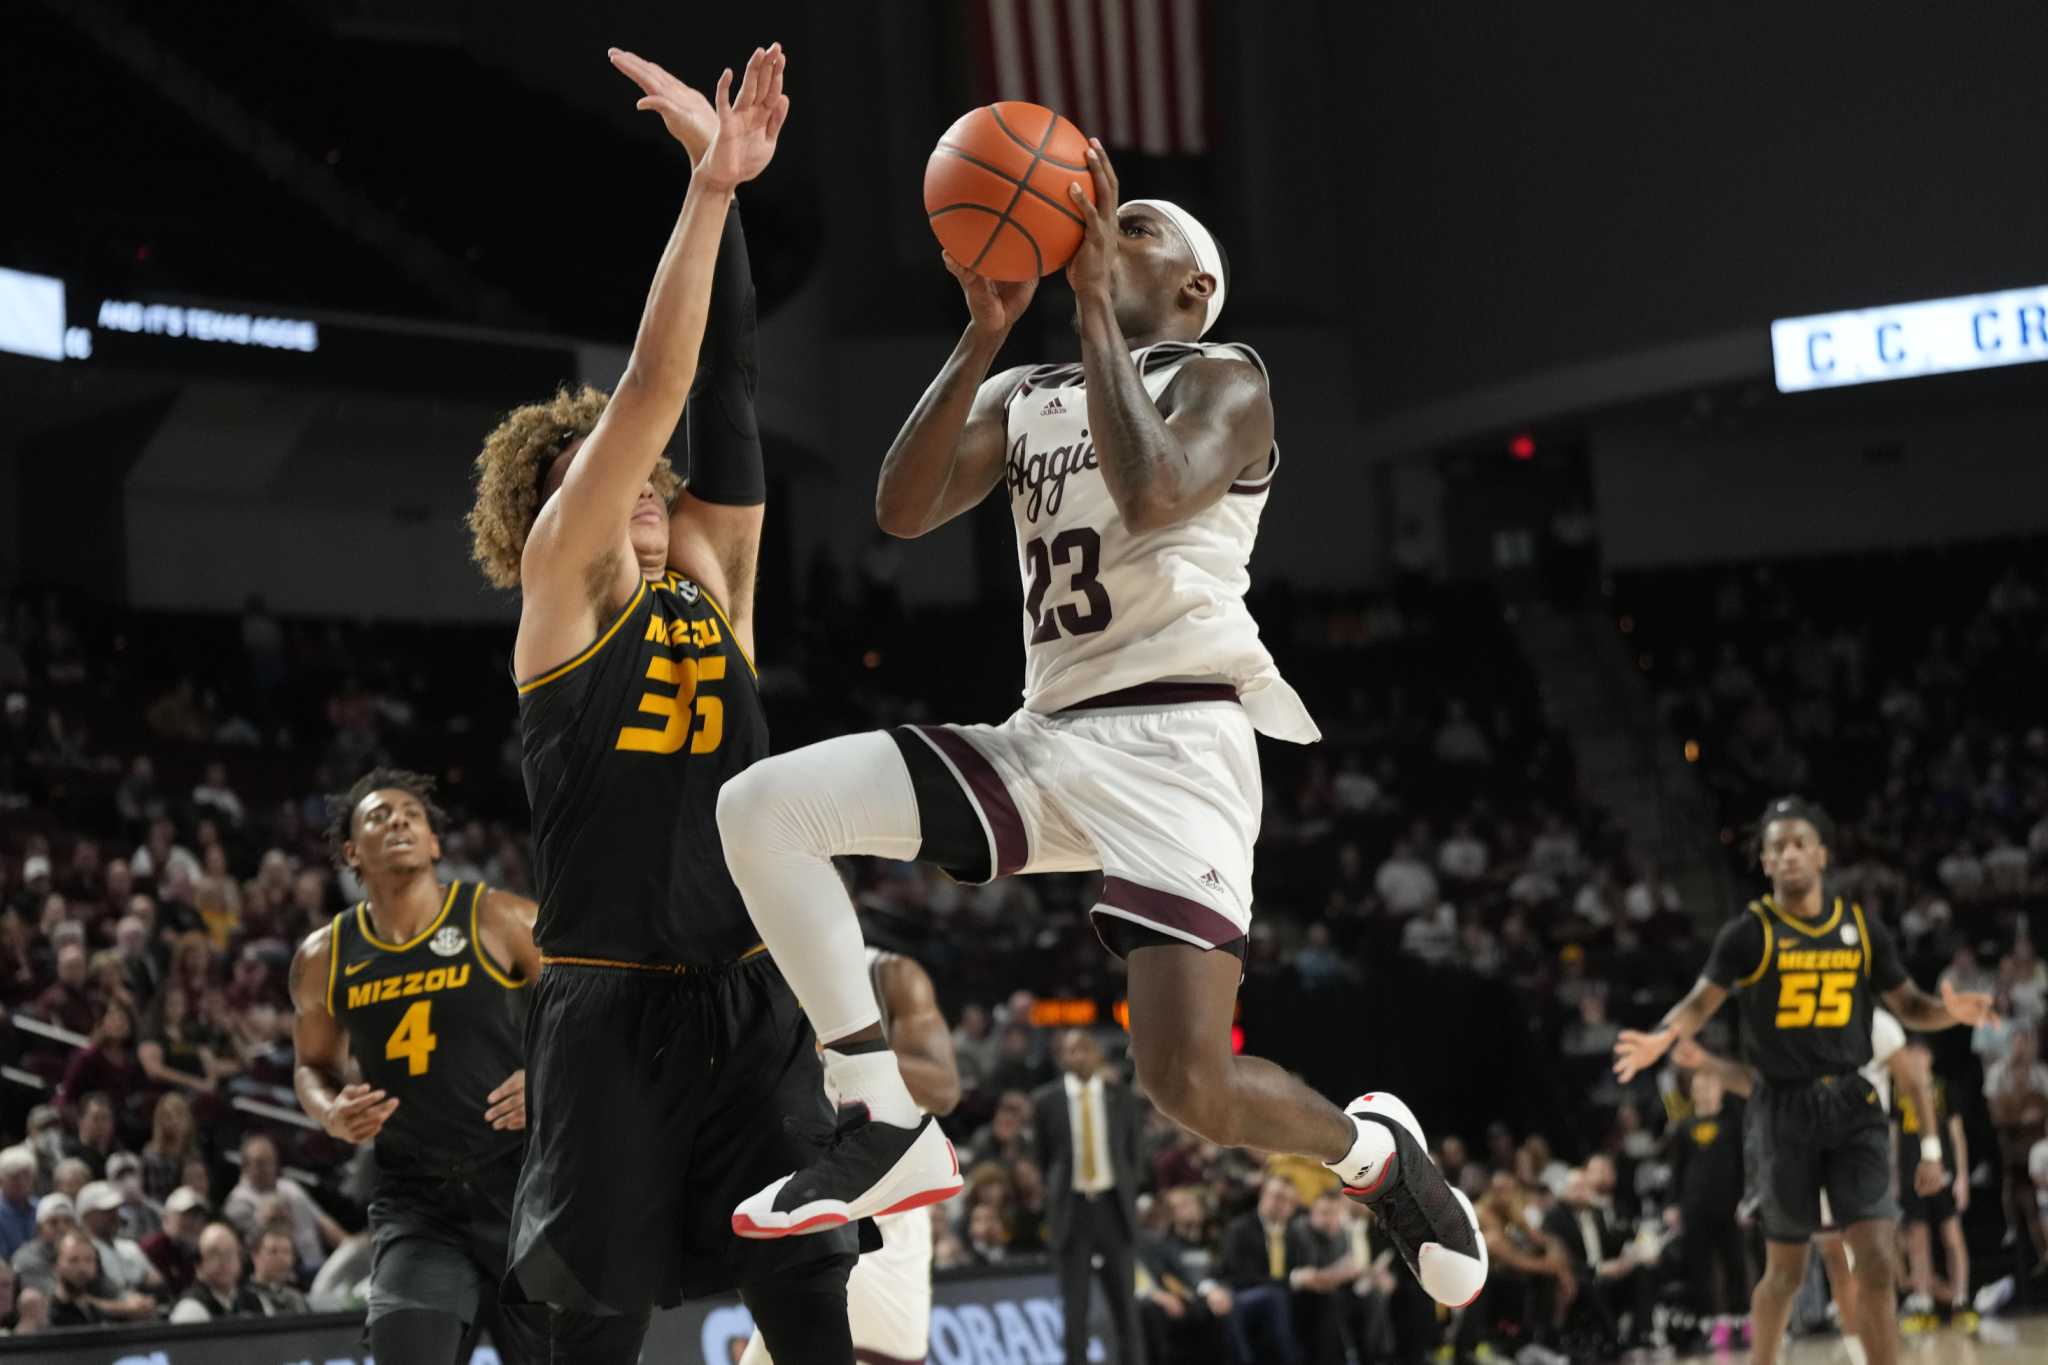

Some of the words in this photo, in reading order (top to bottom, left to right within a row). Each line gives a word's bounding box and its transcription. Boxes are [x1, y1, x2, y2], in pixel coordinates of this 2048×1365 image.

[1026, 526, 1113, 646] 23
[615, 655, 727, 755] 35
[348, 963, 471, 1009] MIZZOU
[1775, 972, 1858, 1028] 55
[385, 1000, 437, 1076] 4
